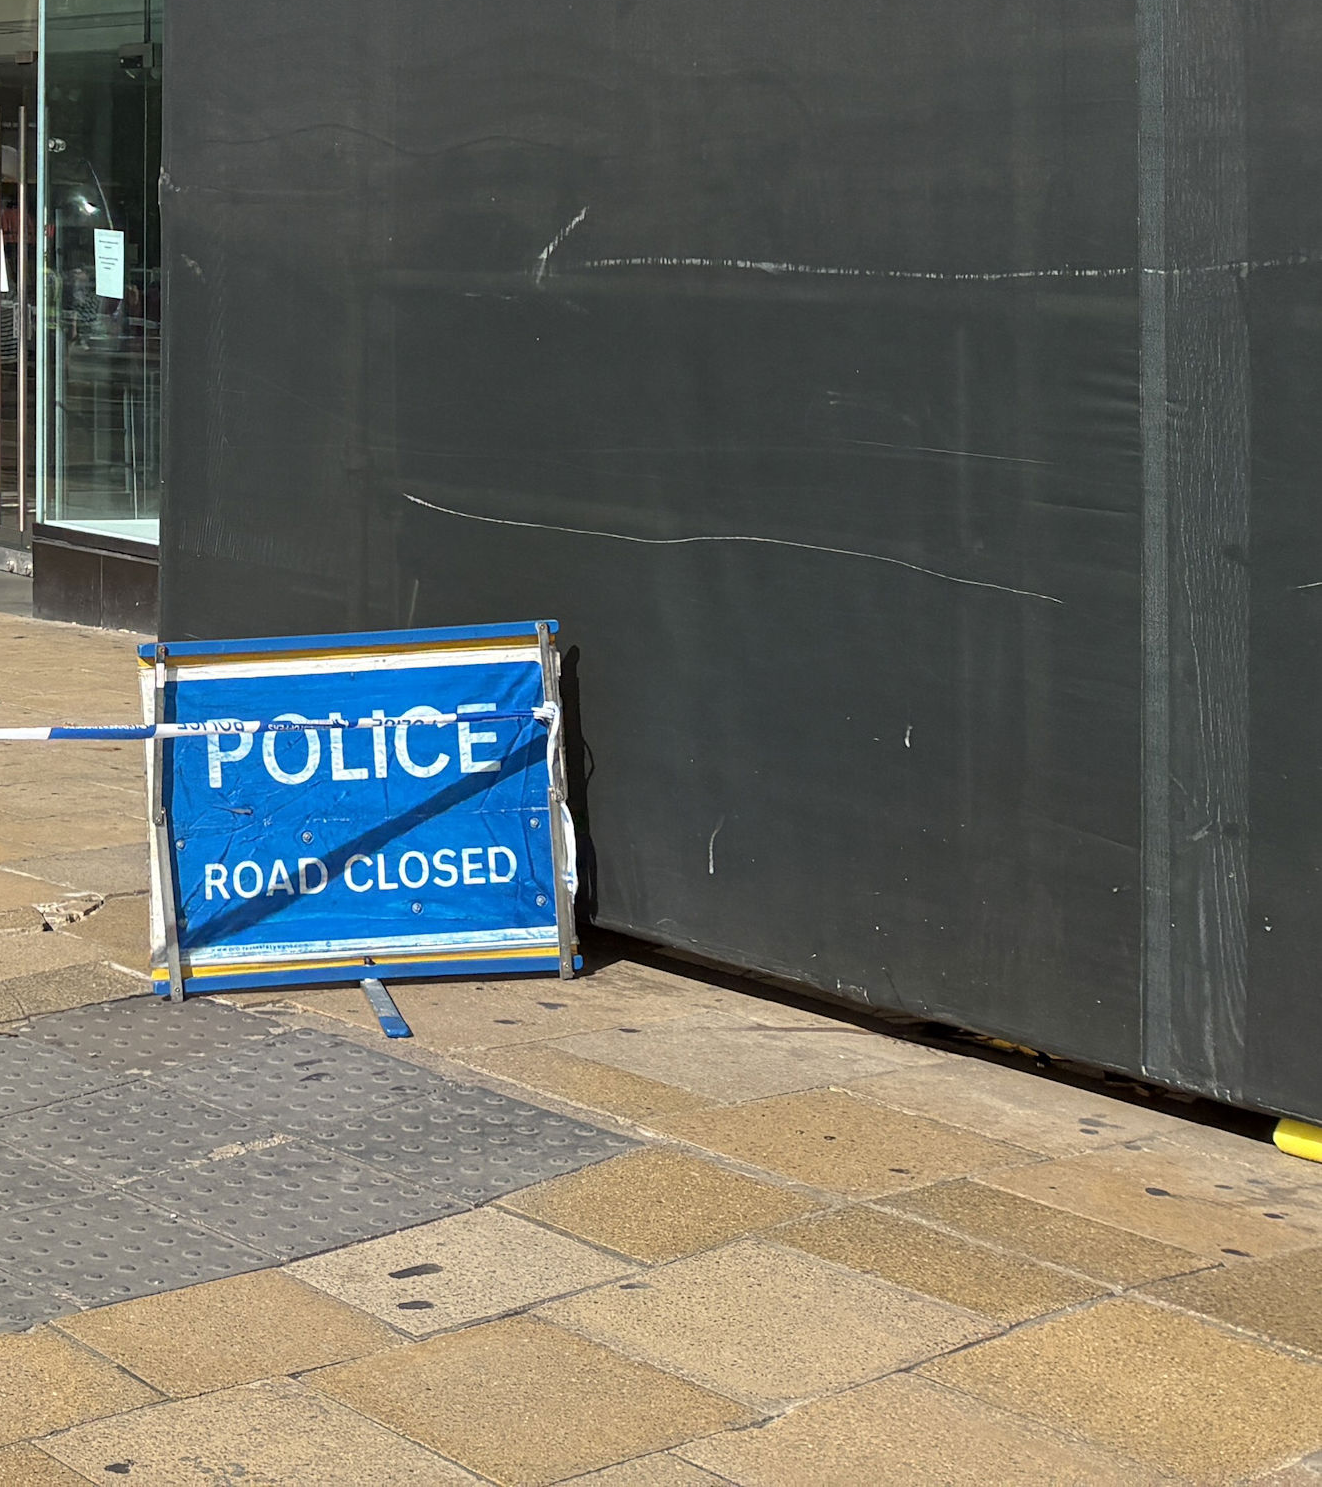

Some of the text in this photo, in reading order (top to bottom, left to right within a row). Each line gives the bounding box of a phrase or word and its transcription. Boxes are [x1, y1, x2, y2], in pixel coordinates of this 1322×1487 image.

[207, 703, 501, 789] POLICE
[205, 846, 517, 901] ROAD CLOSED
